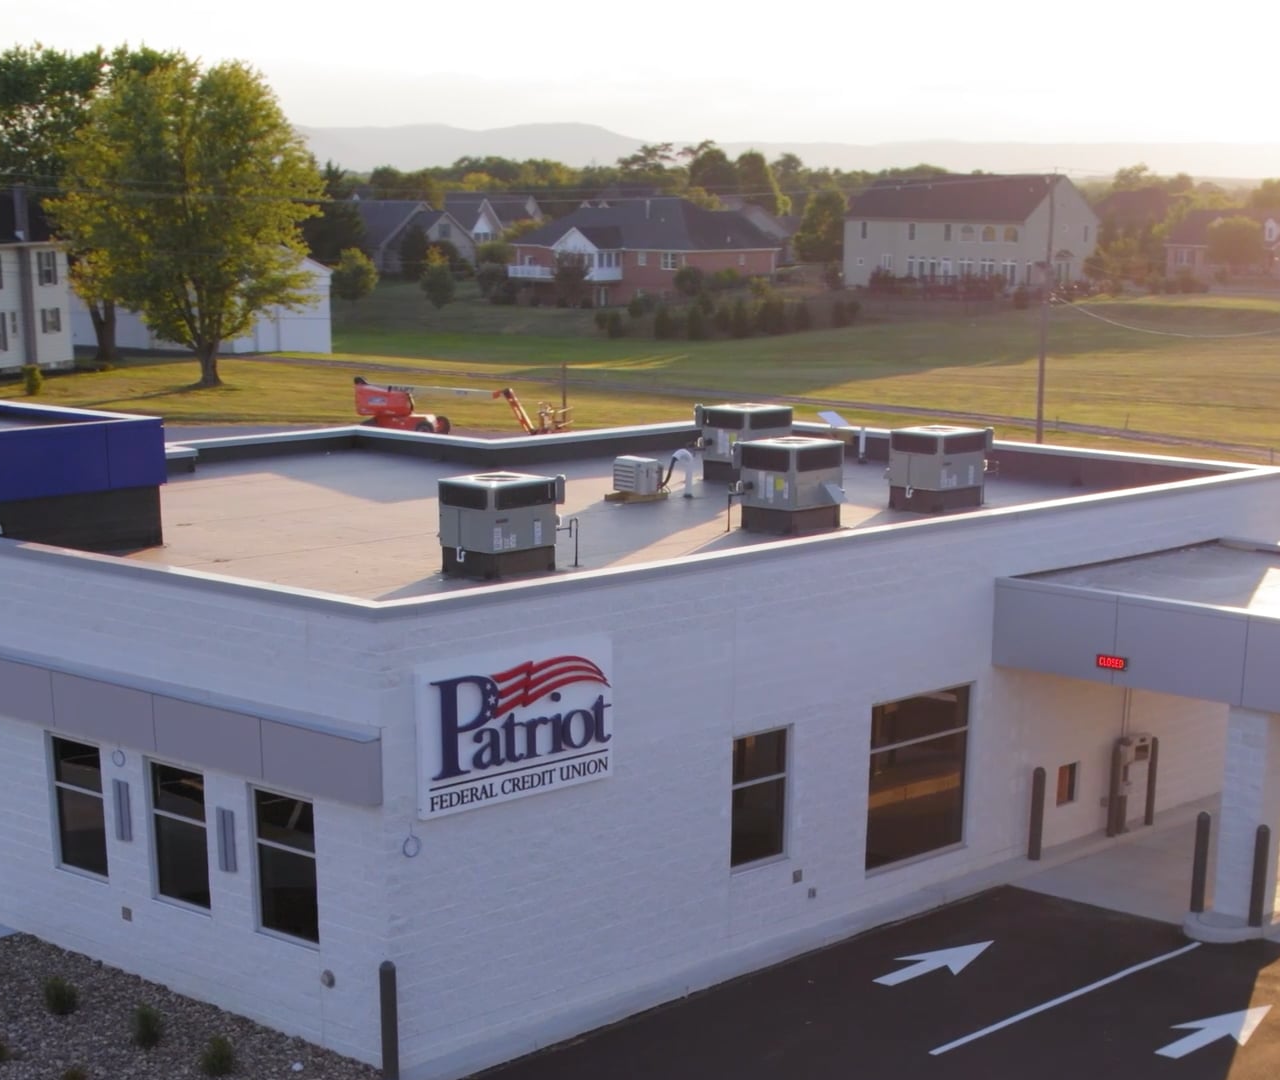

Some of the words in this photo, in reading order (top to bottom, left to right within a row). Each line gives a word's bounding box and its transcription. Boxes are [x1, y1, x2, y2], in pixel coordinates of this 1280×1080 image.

[429, 675, 612, 781] Patriot
[429, 783, 498, 812] FEDERAL
[500, 768, 556, 795] CREDIT
[559, 756, 609, 781] UNION
